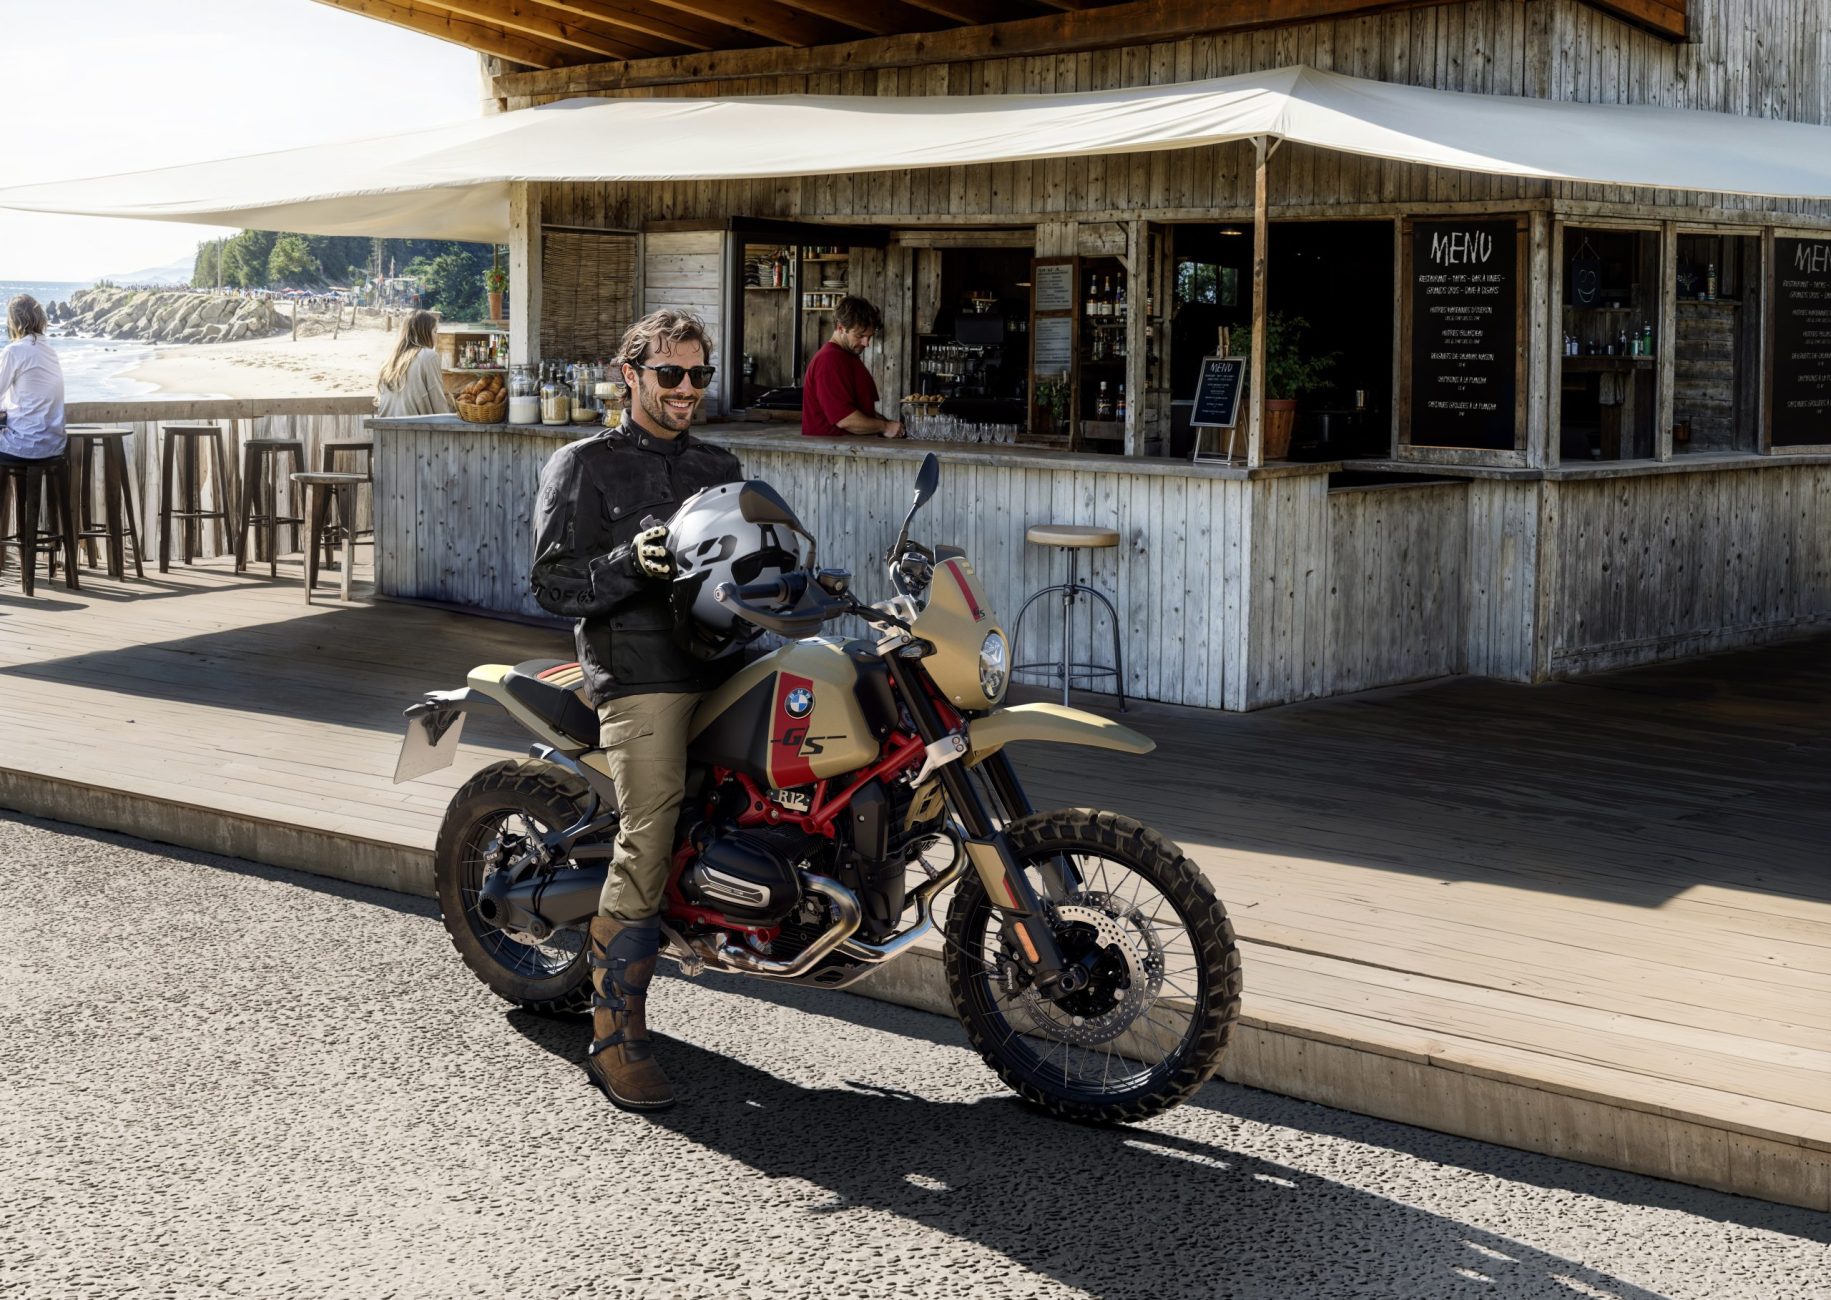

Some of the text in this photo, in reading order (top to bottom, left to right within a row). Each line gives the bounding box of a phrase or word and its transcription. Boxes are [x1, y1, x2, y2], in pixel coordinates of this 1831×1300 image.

[1430, 230, 1492, 267] MENU
[1210, 362, 1233, 373] MENU
[782, 727, 825, 755] GS
[780, 791, 806, 805] R12
